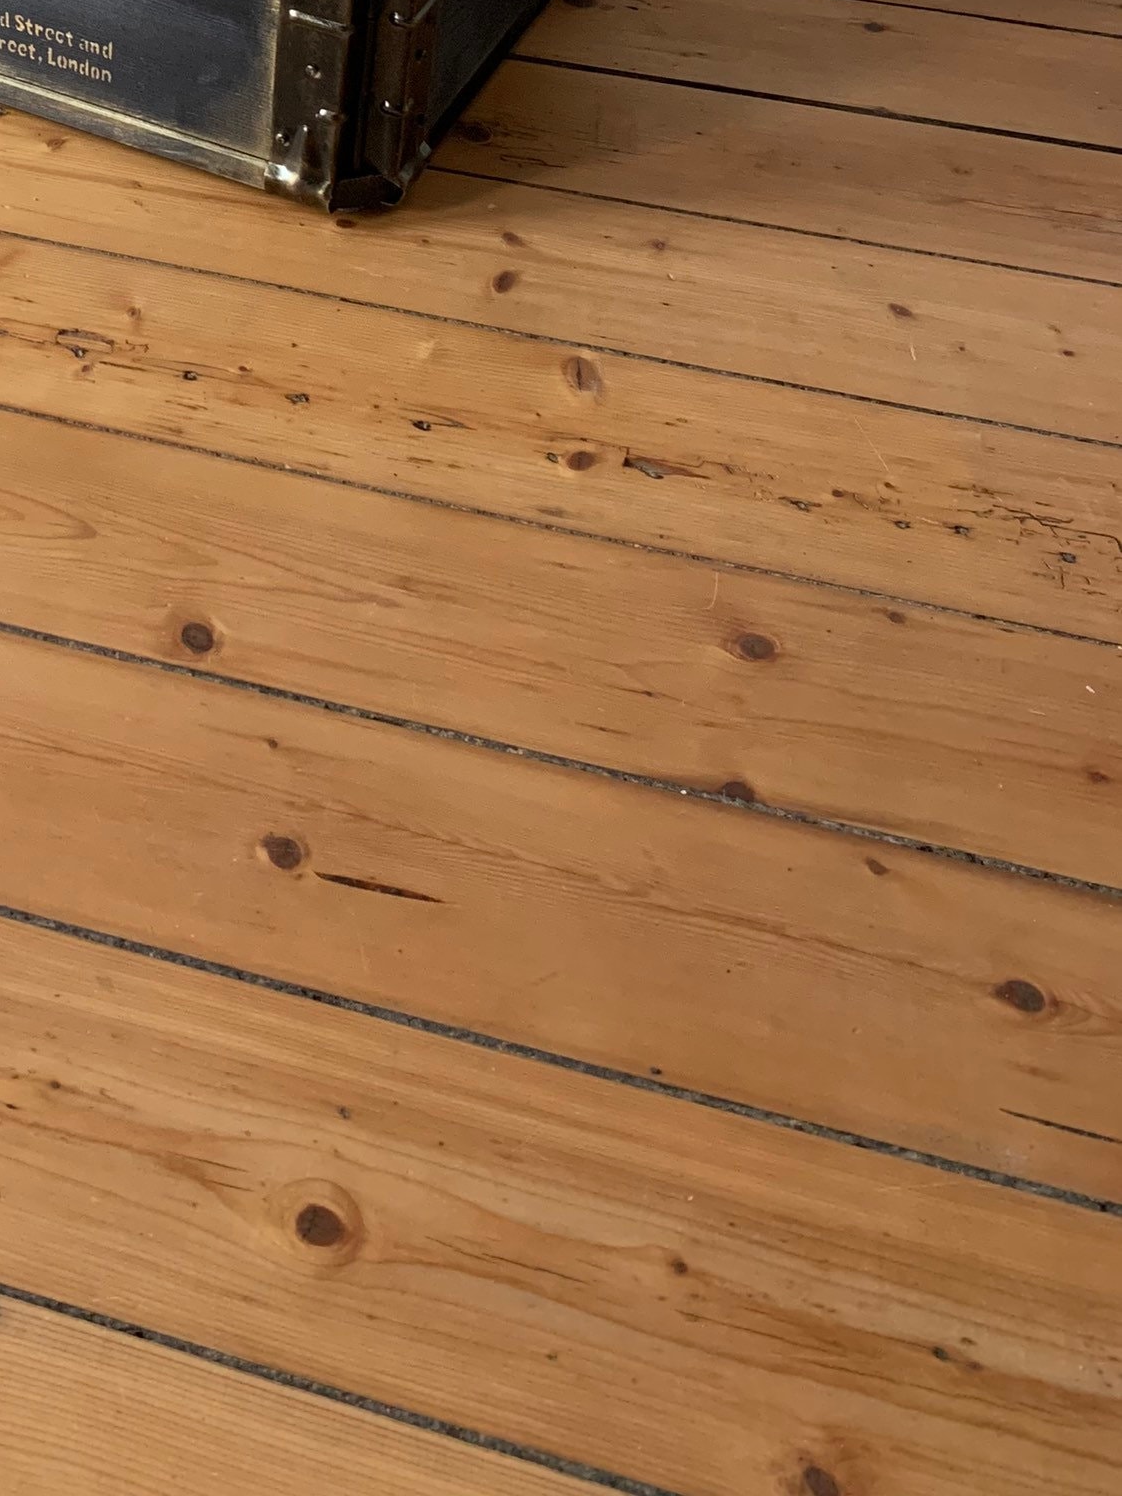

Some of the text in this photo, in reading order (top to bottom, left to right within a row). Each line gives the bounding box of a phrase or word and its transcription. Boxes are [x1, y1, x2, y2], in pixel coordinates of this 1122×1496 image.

[14, 14, 73, 48] Street
[78, 36, 113, 60] and
[47, 47, 113, 84] London
